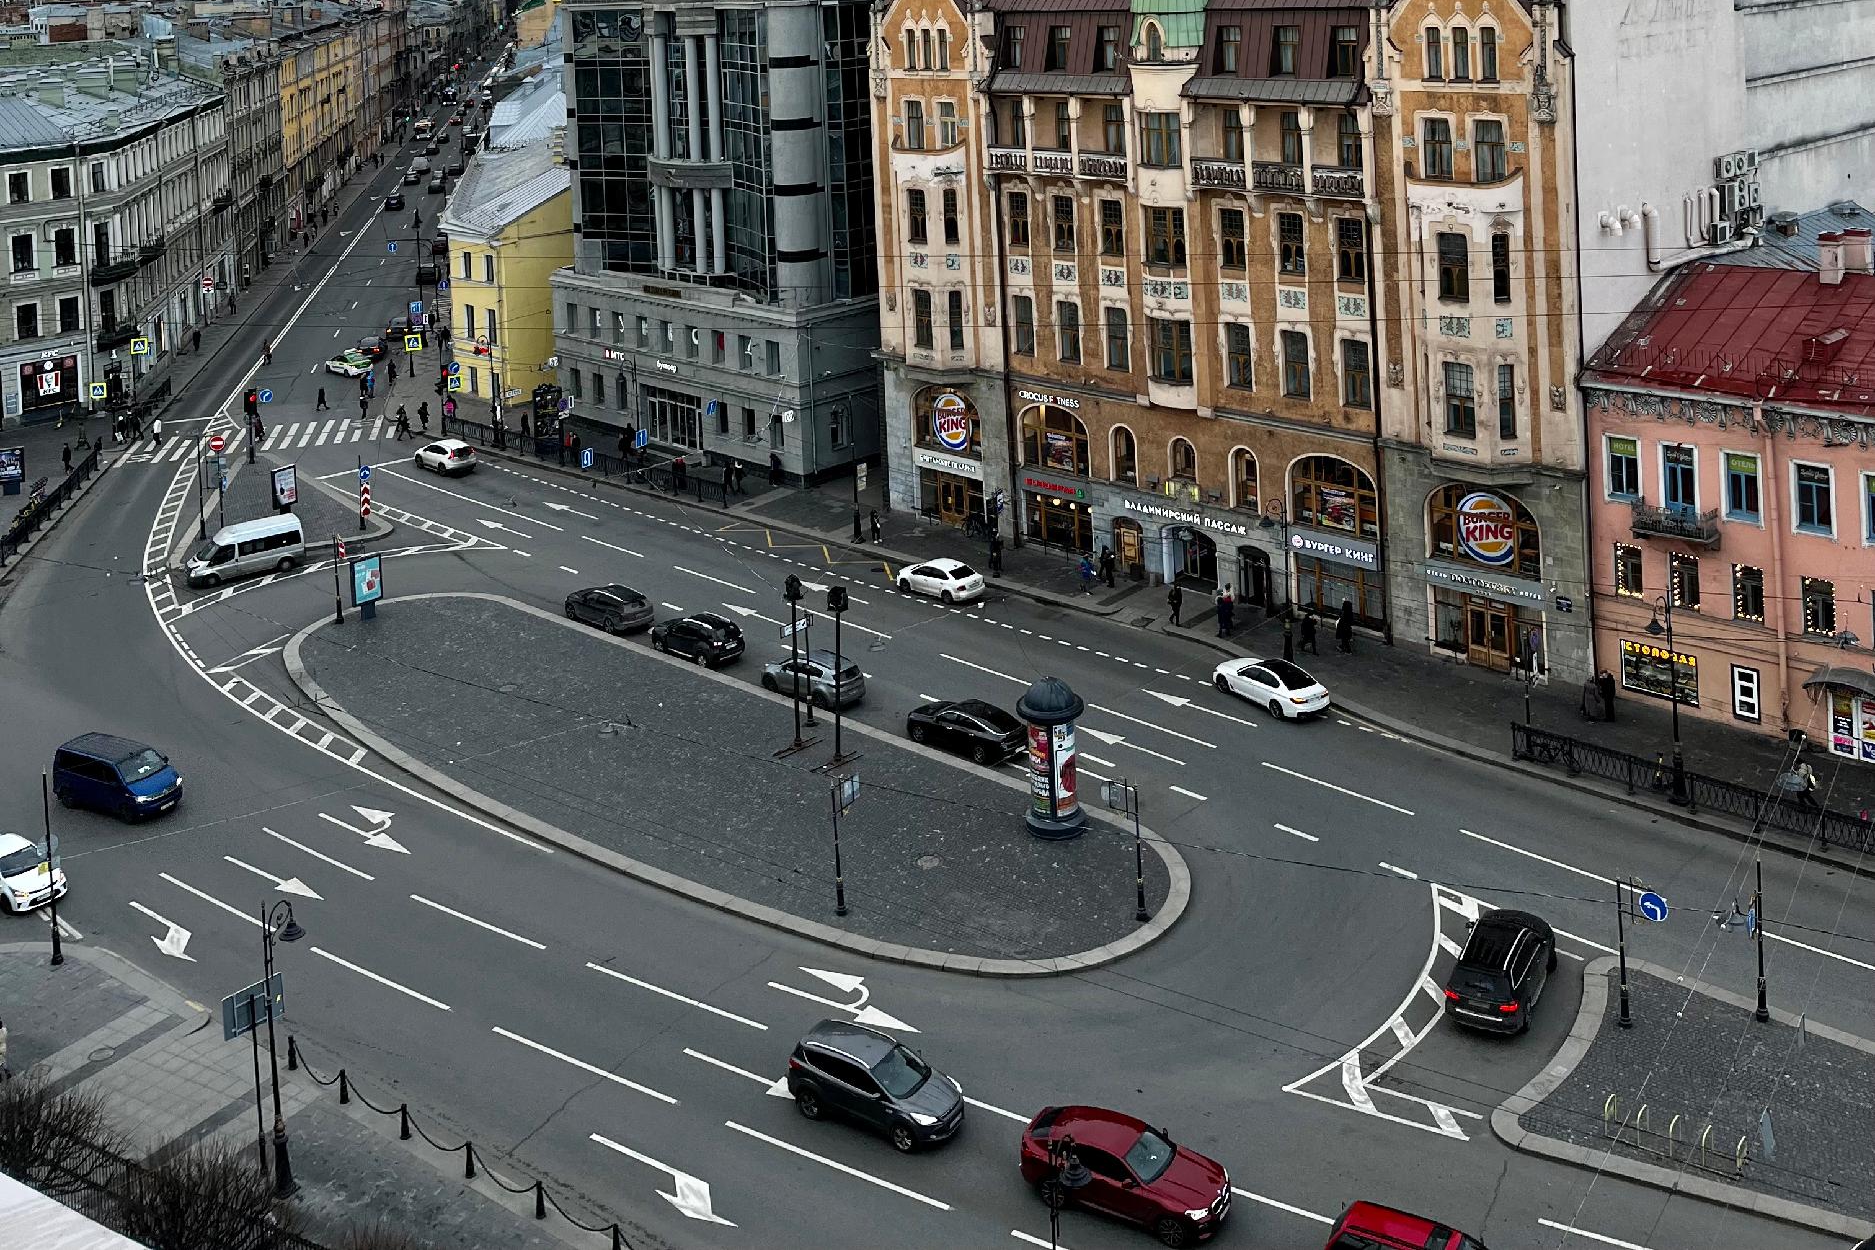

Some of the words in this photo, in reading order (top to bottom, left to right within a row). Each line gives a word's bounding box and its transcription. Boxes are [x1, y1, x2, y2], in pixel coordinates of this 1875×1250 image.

[41, 350, 59, 358] KFC
[42, 387, 57, 395] KFC
[1019, 390, 1048, 403] CROCUS
[939, 417, 967, 433] KING
[1613, 442, 1635, 452] HOTEL
[1731, 459, 1756, 469] ОТЕЛЬ
[1124, 499, 1201, 526] ВЛАДИМИРСКИЙ
[1204, 517, 1247, 535] ПАССАЖ
[1465, 524, 1513, 543] KING
[1304, 539, 1342, 555] БУРГЕР
[1345, 548, 1374, 563] КИНГ
